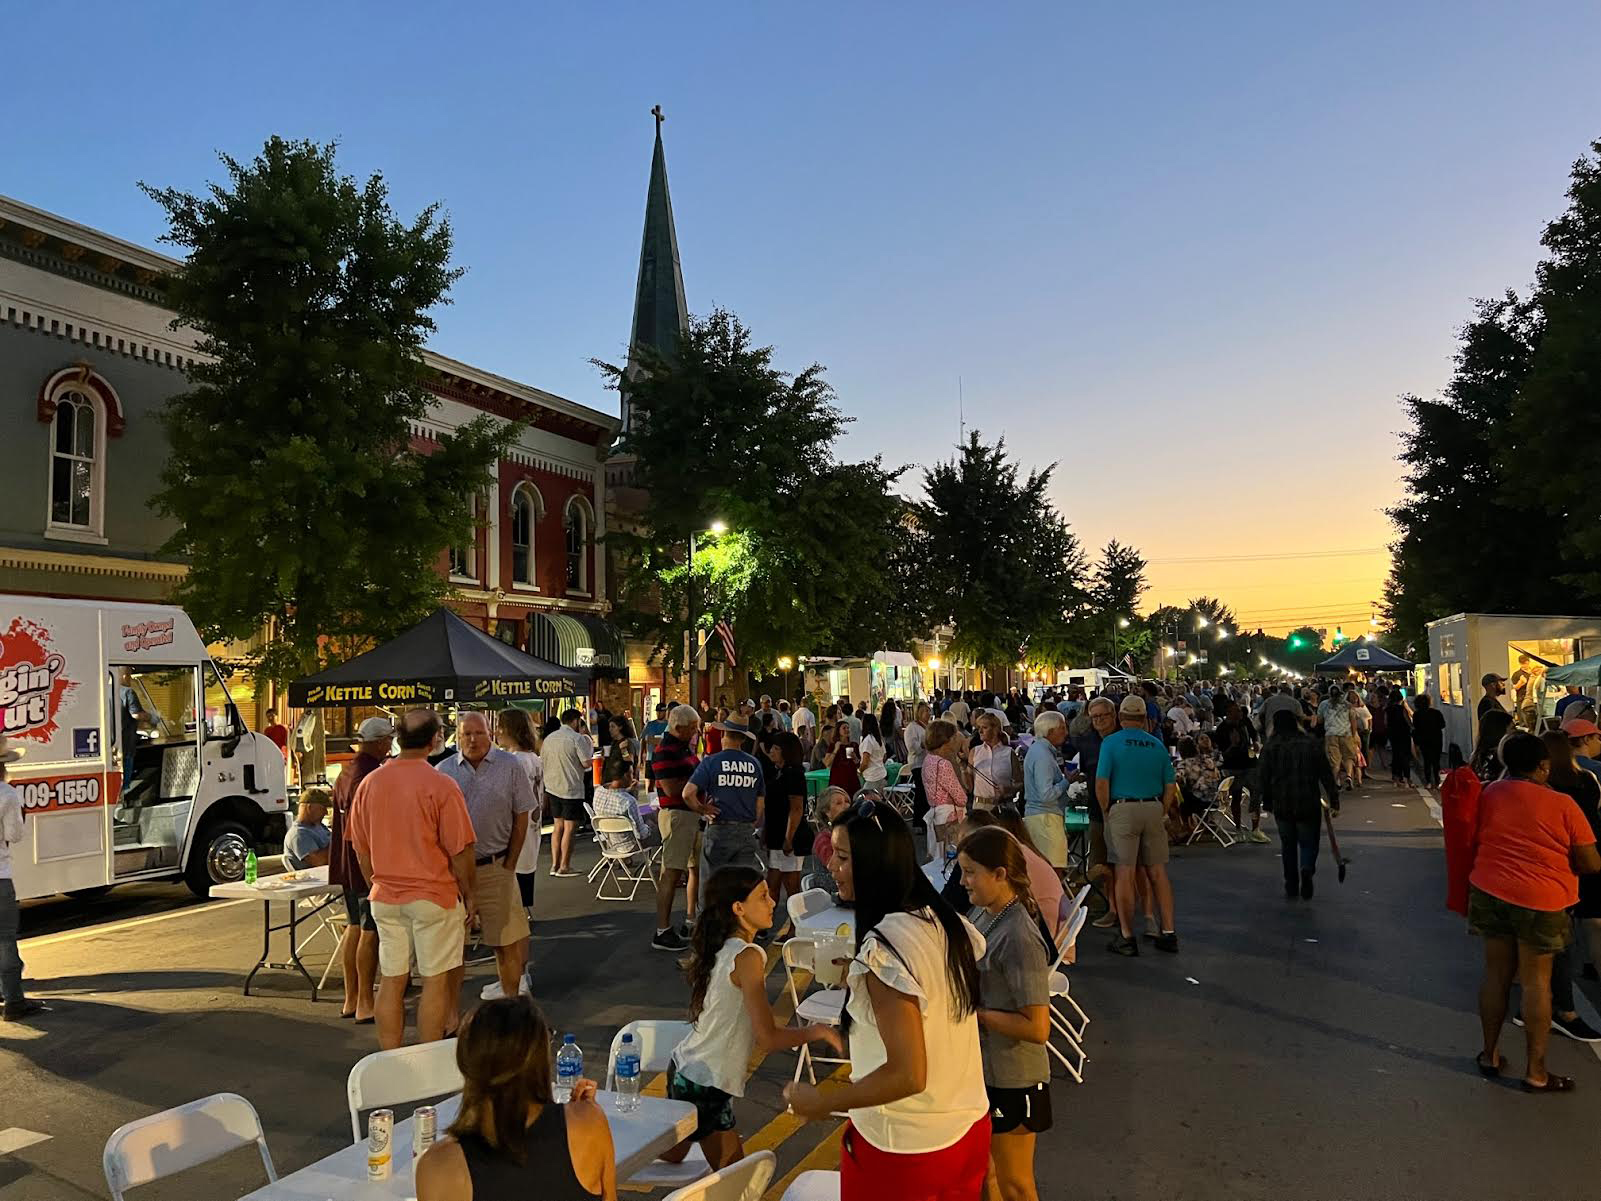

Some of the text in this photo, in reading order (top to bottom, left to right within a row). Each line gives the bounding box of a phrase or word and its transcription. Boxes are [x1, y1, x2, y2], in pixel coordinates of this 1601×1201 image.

[0, 659, 60, 706] gin'
[491, 680, 530, 695] KETTLE
[535, 679, 562, 693] CORN
[326, 686, 372, 701] KETTLE
[379, 683, 415, 699] CORN
[1124, 739, 1155, 748] STAFF
[721, 761, 755, 773] BAND
[718, 774, 757, 788] BUDDY
